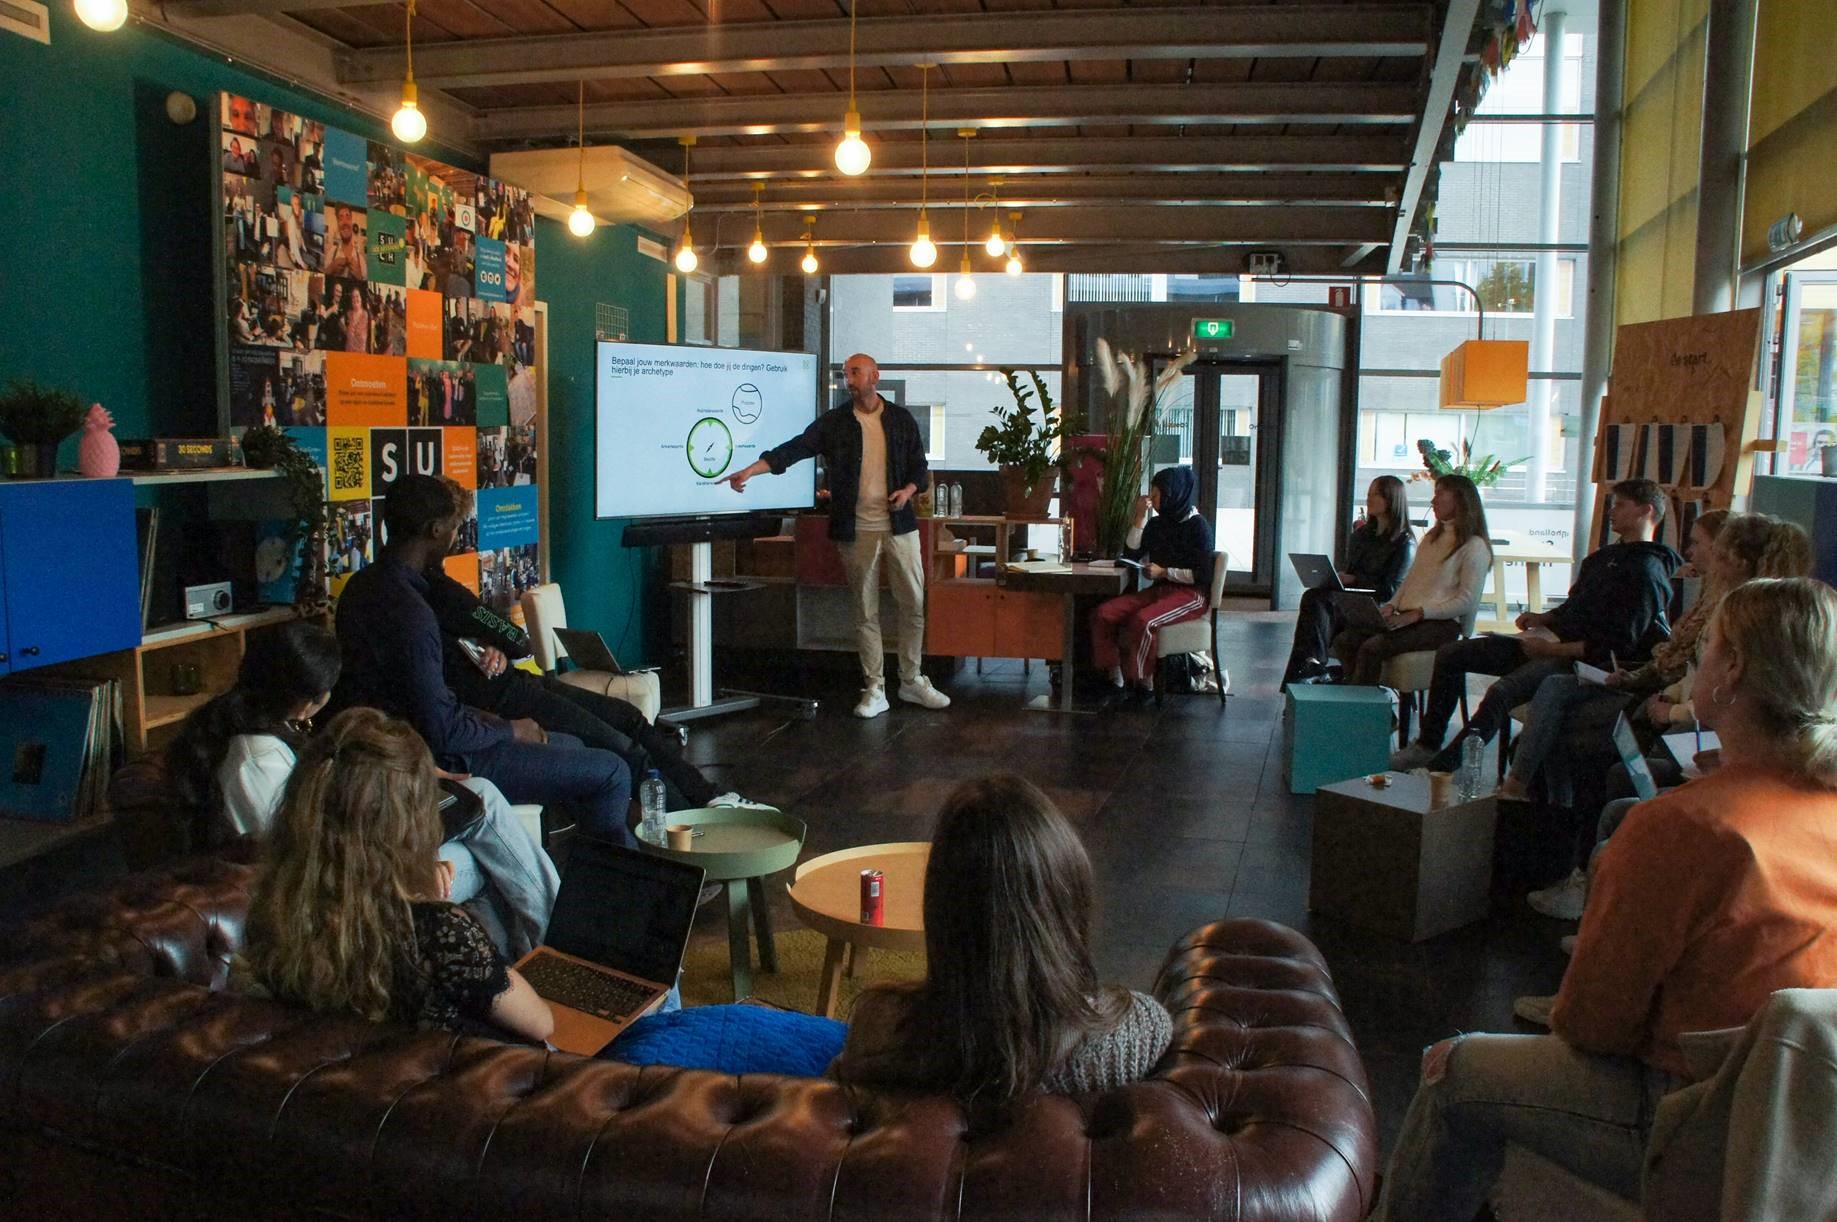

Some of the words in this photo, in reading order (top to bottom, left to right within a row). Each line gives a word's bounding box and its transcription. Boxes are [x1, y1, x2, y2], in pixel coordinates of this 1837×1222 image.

[611, 356, 635, 366] Bepaal
[637, 358, 653, 367] jouw
[654, 359, 699, 368] merkwaarden:
[700, 361, 713, 369] hoe
[713, 361, 725, 369] doe
[733, 362, 741, 370] de
[741, 363, 765, 373] dingen?
[766, 363, 788, 372] Gebruik
[611, 366, 632, 376] hierbij
[633, 367, 640, 377] je
[641, 367, 674, 377] archetype
